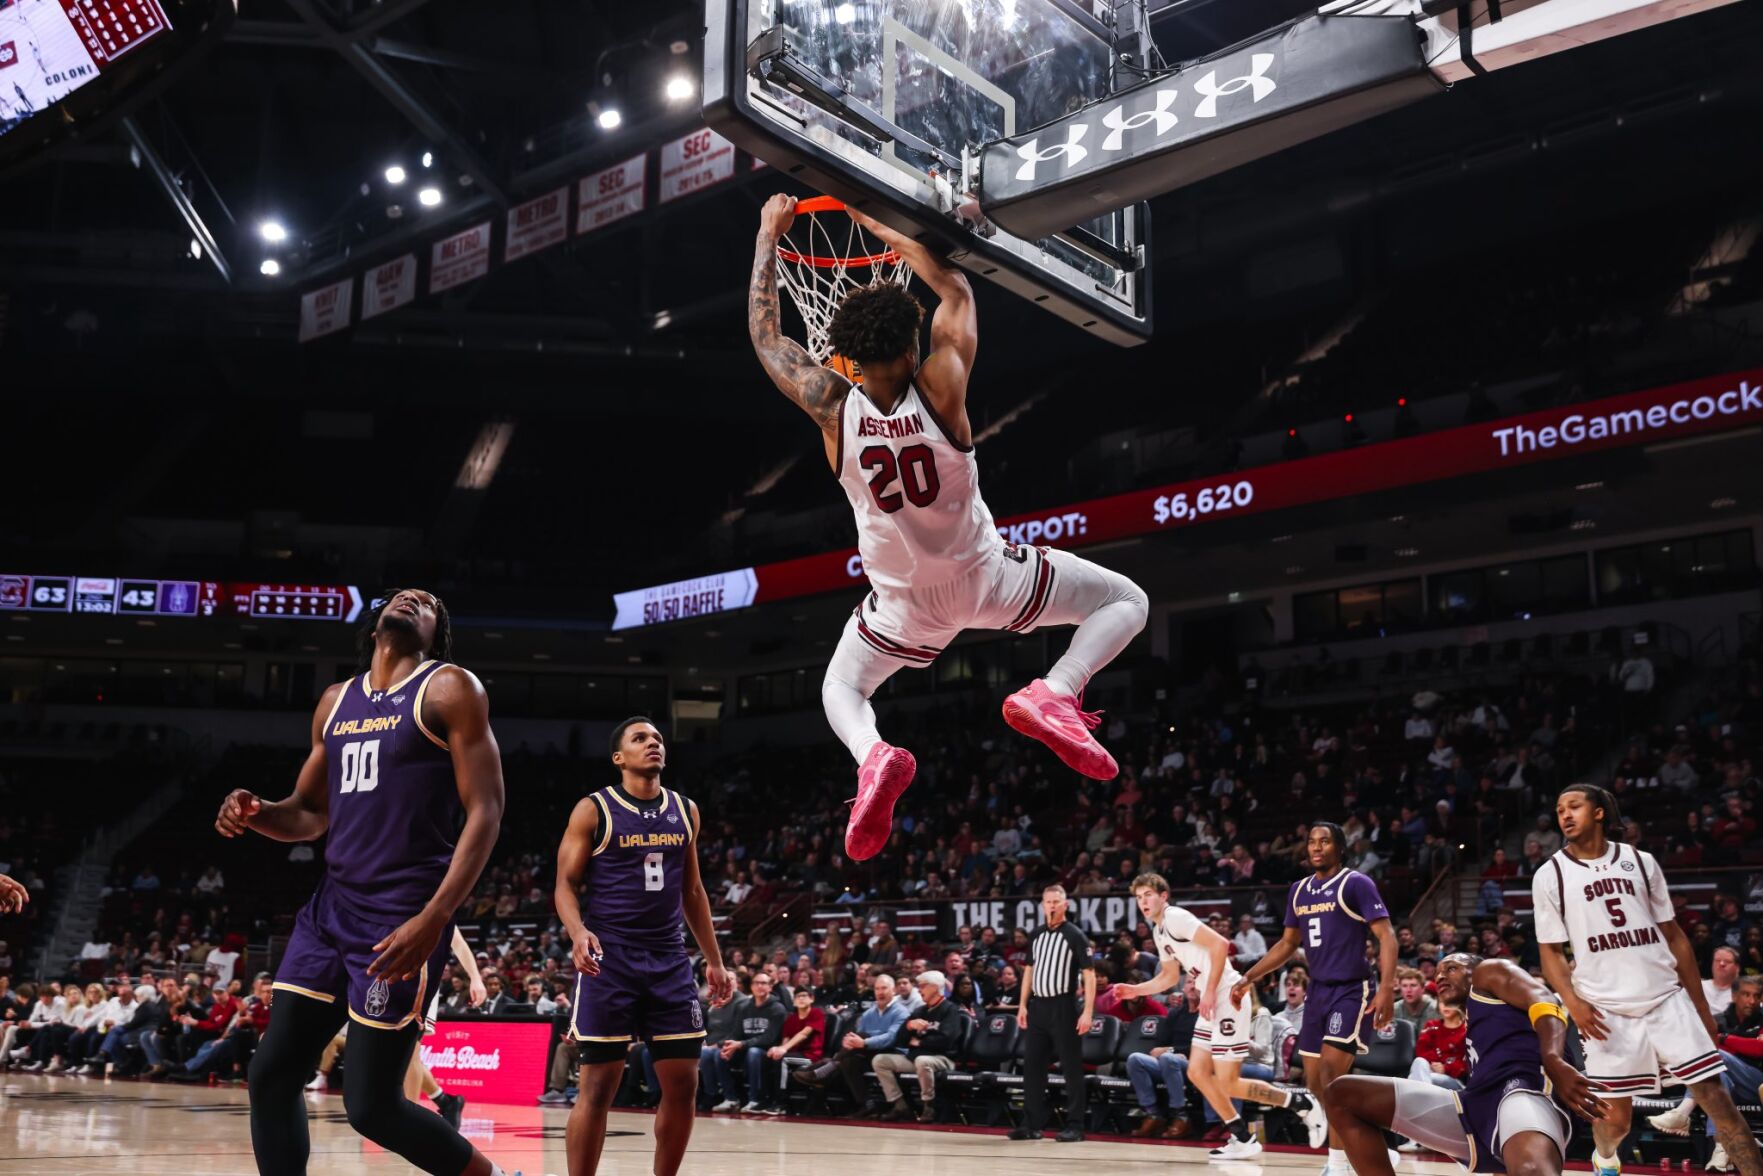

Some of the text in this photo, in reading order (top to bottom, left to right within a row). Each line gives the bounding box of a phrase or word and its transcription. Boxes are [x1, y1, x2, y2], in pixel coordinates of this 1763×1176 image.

[683, 131, 710, 159] SEC
[599, 168, 625, 194] SEC
[516, 195, 558, 226] METRO
[441, 231, 480, 260] METRO
[858, 413, 924, 438] ASSEMIAN
[1492, 381, 1763, 455] TheGamecock
[859, 443, 940, 513] 20
[1153, 481, 1253, 523] $6,620
[997, 513, 1087, 544] KPOT:
[34, 587, 66, 603] 63
[123, 590, 155, 606] 43
[643, 589, 724, 624] 50/50 RAFFLE
[333, 715, 402, 736] UALBANY
[340, 739, 380, 794] 00
[619, 833, 685, 848] UALBANY
[644, 853, 664, 891] 8
[1584, 878, 1635, 902] SOUTH
[952, 897, 1137, 935] THE CKPI
[1296, 902, 1336, 915] UALBANY
[1605, 898, 1626, 927] 5
[1308, 918, 1322, 947] 2
[1587, 927, 1660, 953] CAROLINA
[445, 1031, 470, 1040] VISIT
[457, 1046, 500, 1070] Beach
